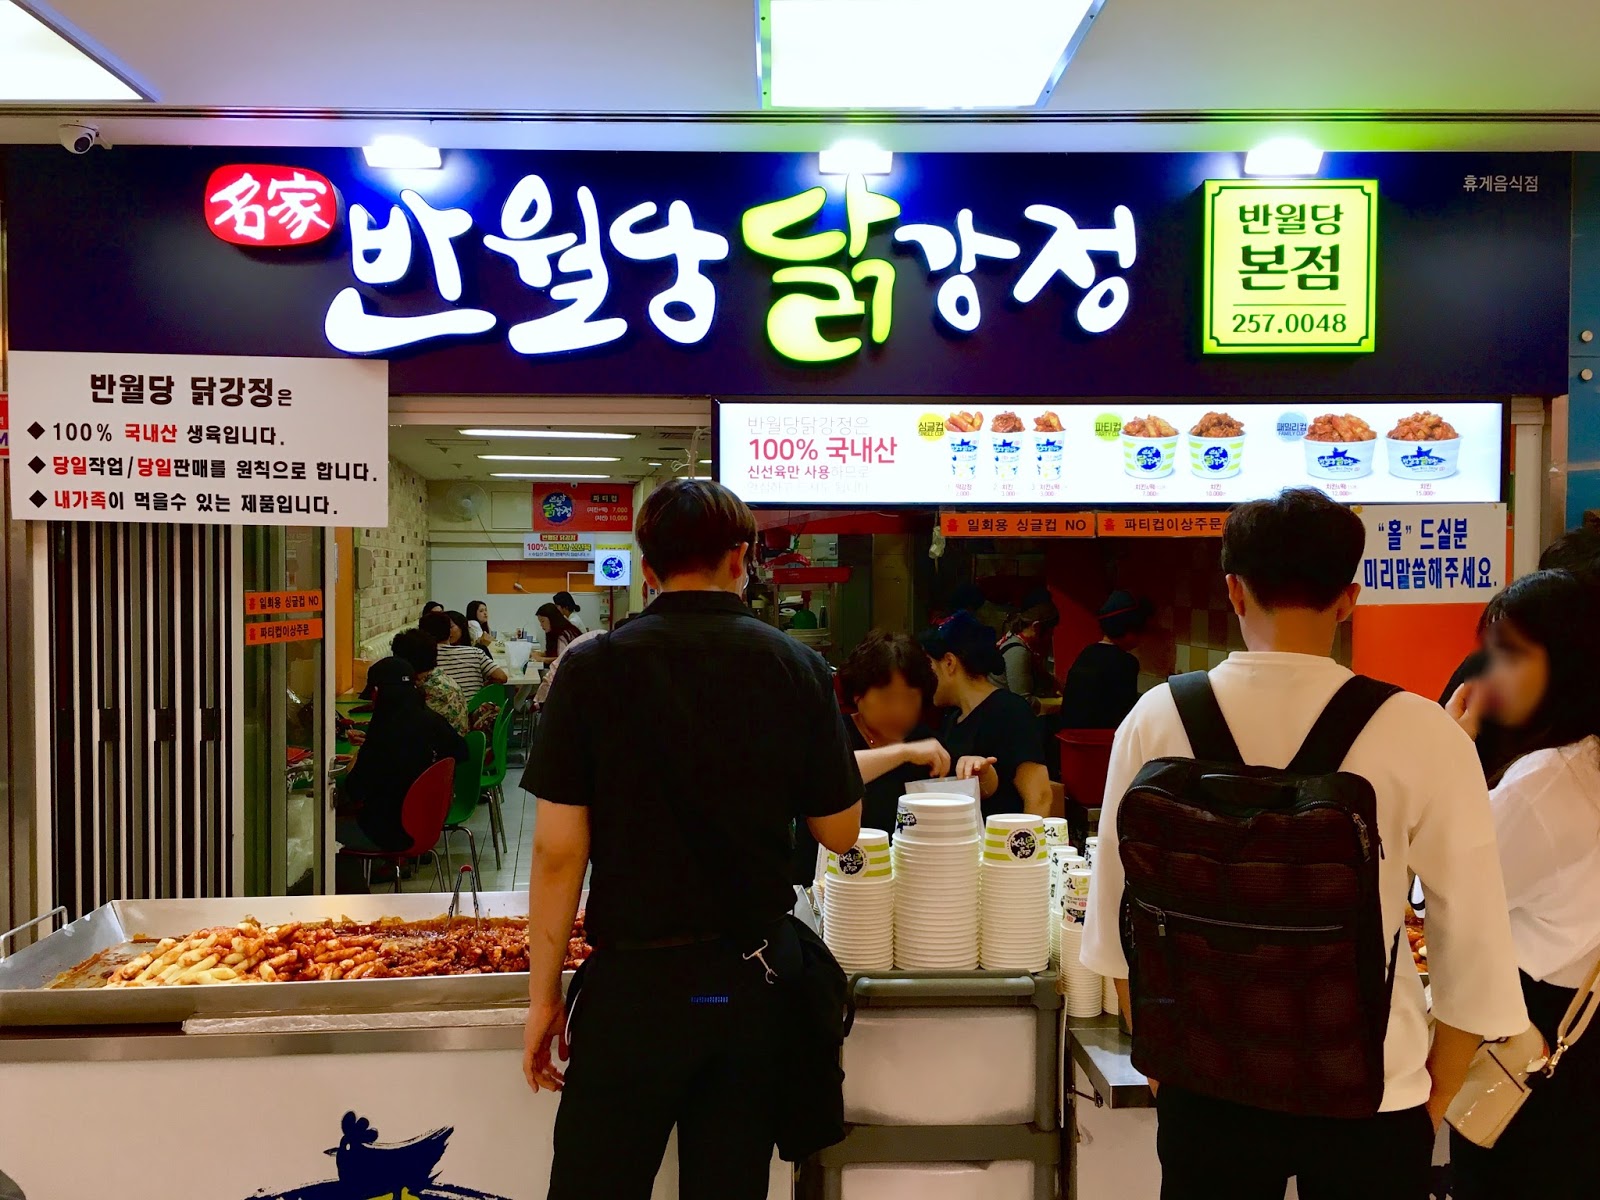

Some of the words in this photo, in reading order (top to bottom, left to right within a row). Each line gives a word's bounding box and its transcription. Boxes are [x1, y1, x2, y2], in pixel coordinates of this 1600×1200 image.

[1463, 175, 1538, 192] 휴게음식점
[209, 172, 332, 240] 名家
[1239, 204, 1344, 235] 반월당
[323, 173, 730, 354] 반월당
[1238, 244, 1340, 291] 본점
[1232, 314, 1347, 333] 257.0048
[90, 374, 174, 405] 반월당
[190, 377, 292, 407] 닭강정은
[53, 423, 112, 442] 100%
[125, 424, 177, 443] 국내산
[187, 424, 285, 446] 생육입니다.
[748, 416, 870, 436] 반월당닭강정은
[918, 421, 944, 432] 싱글컵
[1095, 422, 1121, 432] 파티컵
[749, 438, 819, 461] 100%
[826, 436, 898, 464] 국내산
[236, 460, 307, 480] 원칙으로
[316, 462, 378, 482] 합니다.
[748, 465, 800, 480] 신선육만
[54, 491, 124, 511] 내가족이
[134, 492, 187, 511] 먹을수
[196, 493, 231, 513] 있는
[241, 494, 339, 515] 제품입니다.
[947, 518, 959, 532] 홀
[967, 519, 1008, 531] 일회용
[1017, 518, 1057, 531] 싱글컵
[1065, 519, 1087, 530] NO
[1104, 518, 1116, 531] 홀
[1124, 517, 1223, 531] 파티컵이상주문
[1420, 518, 1468, 549] 드실분
[527, 543, 548, 551] 100%
[1364, 556, 1497, 589] 미리말씀해주세요.
[260, 596, 281, 609] 일회용
[285, 595, 305, 608] 싱글컵
[308, 595, 319, 605] NO
[260, 624, 309, 639] 파티컵이상주문
